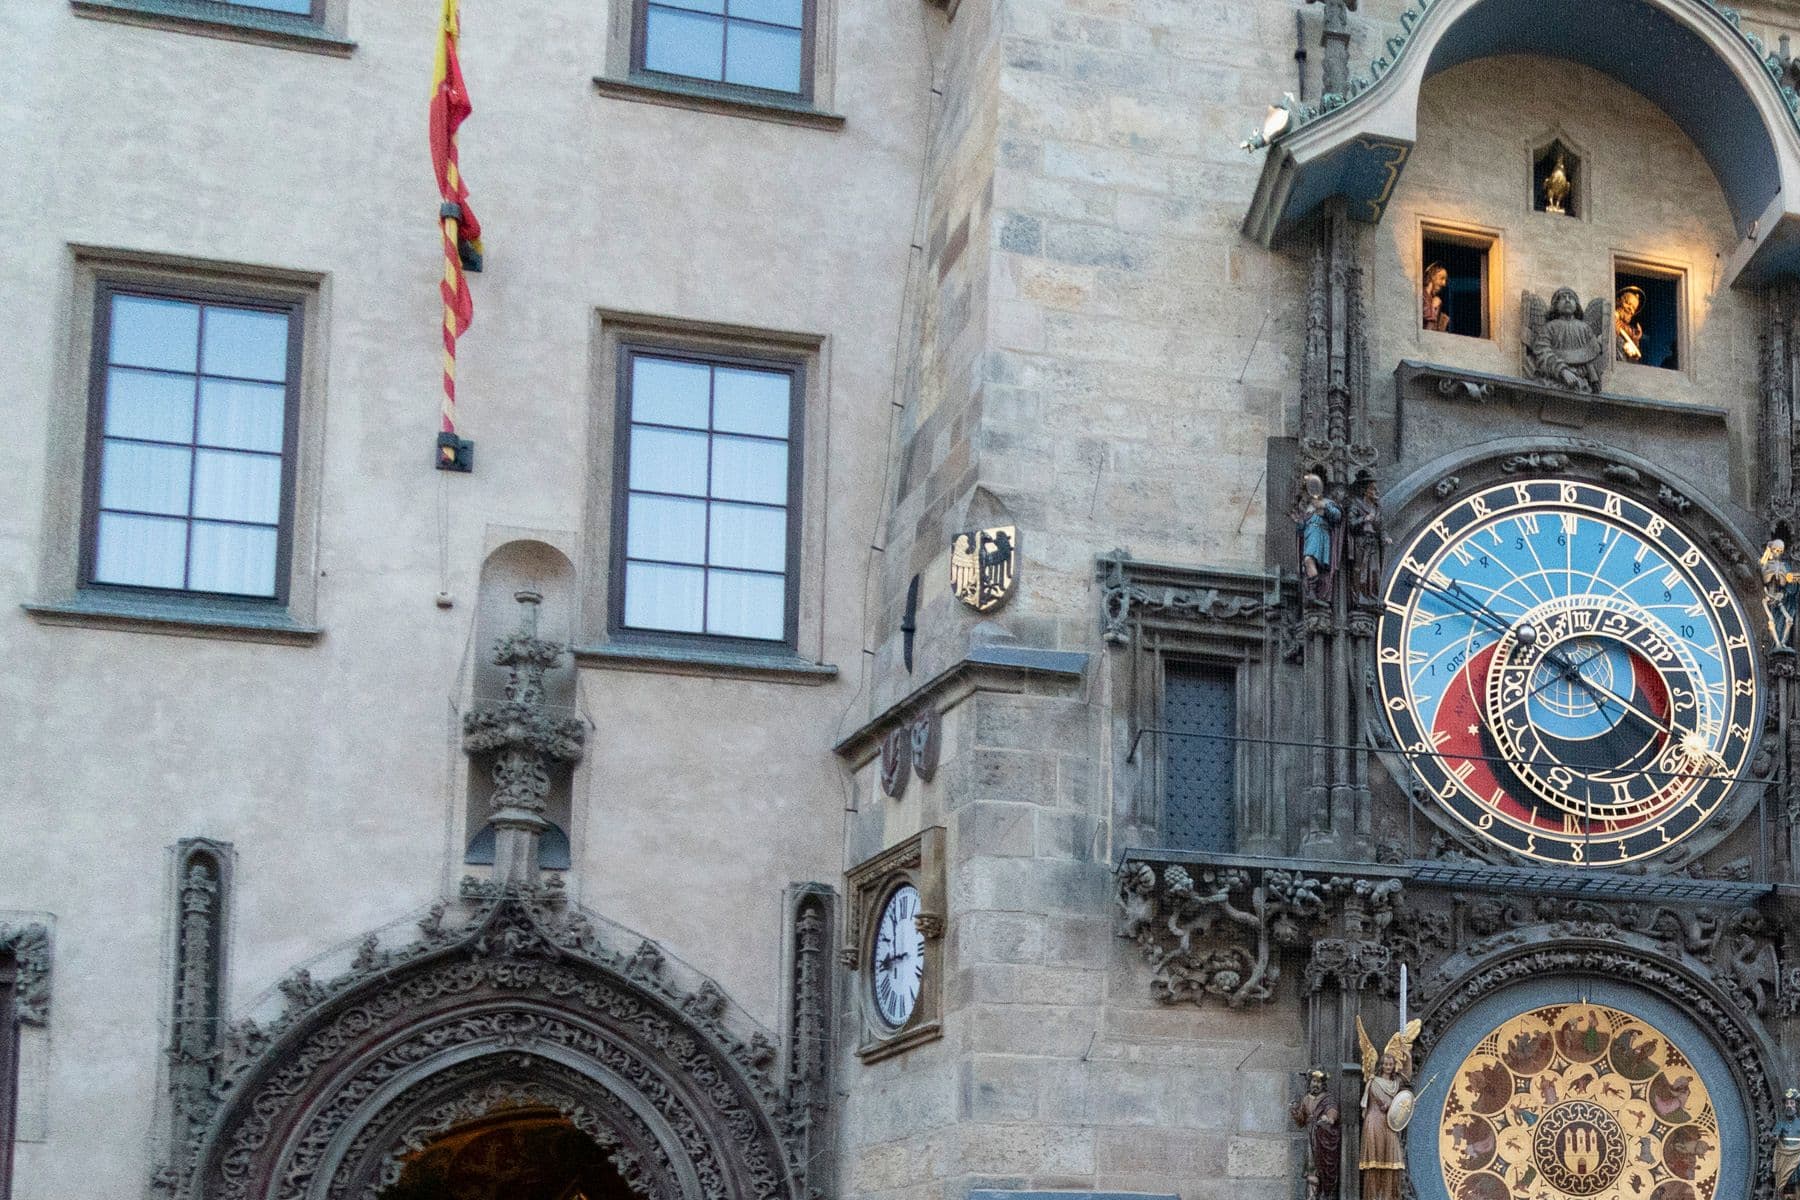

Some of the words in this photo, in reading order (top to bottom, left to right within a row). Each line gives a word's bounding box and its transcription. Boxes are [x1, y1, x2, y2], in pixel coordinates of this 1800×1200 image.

[1560, 483, 1577, 504] 16
[1522, 514, 1540, 536] XI
[1560, 514, 1579, 535] XII
[1485, 524, 1504, 546] X
[1557, 535, 1567, 547] 6
[1514, 537, 1524, 551] 5
[1598, 543, 1606, 554] 7
[1634, 543, 1649, 563] II
[1479, 556, 1490, 569] 4
[1633, 562, 1641, 575] 8
[1661, 569, 1682, 590] III
[1663, 591, 1672, 603] 9
[1434, 622, 1443, 636] 2
[1680, 625, 1695, 638] 10
[1431, 664, 1436, 677] 1
[1454, 759, 1476, 781] III
[1488, 787, 1505, 808] II
